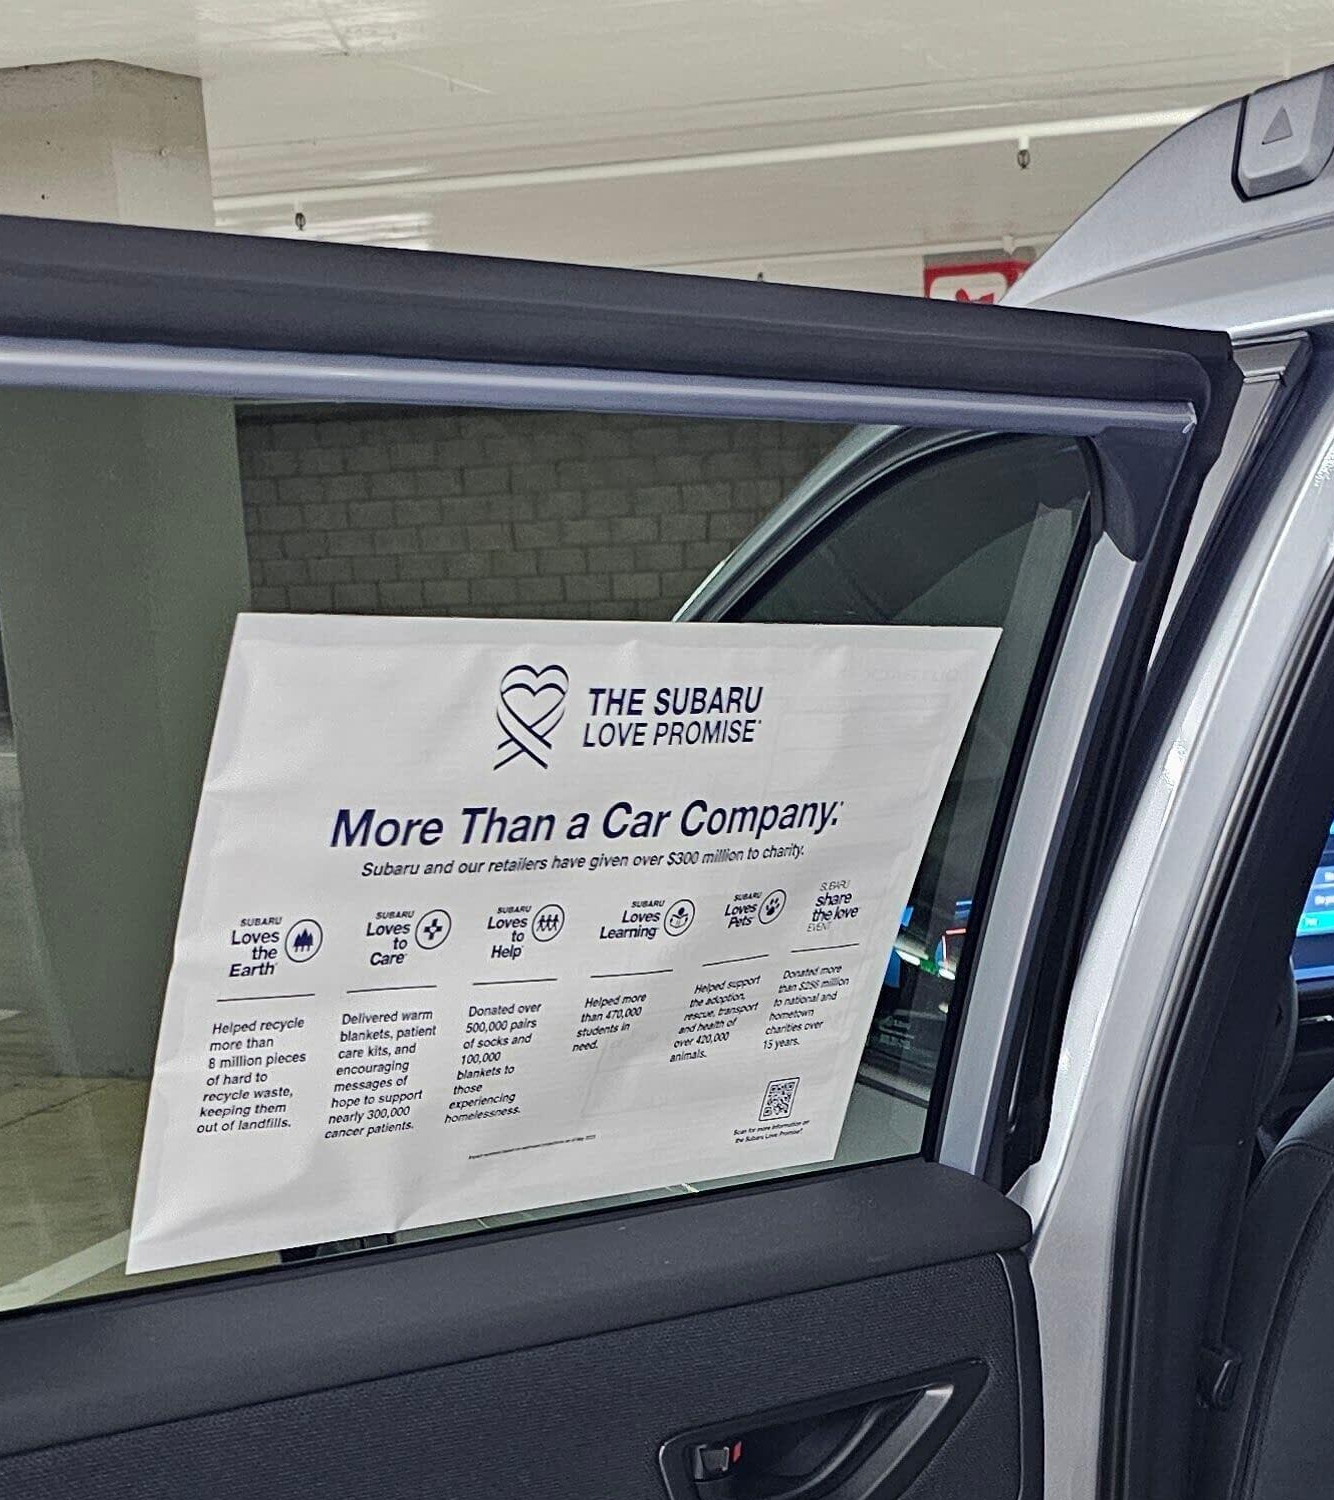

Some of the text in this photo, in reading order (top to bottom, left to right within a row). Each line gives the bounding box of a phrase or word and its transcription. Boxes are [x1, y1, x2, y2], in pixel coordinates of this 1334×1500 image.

[588, 686, 763, 716] THE SUBARU
[582, 722, 648, 748] LOVE
[330, 808, 444, 848] More
[461, 806, 556, 845] Than
[565, 812, 591, 841] a
[602, 801, 671, 839] Car
[361, 843, 805, 877] Subaru and our retailers have given over $300 million to charity.
[733, 892, 762, 901] SUBARU
[816, 892, 852, 907] share
[497, 906, 531, 914] SUBARU
[631, 900, 665, 908] SUBARU
[725, 903, 758, 916] Loves
[376, 910, 415, 920] SUBARU
[622, 910, 660, 923] Loves
[812, 906, 859, 922] the love
[240, 917, 282, 926] SUBARU
[487, 917, 528, 930] Loves
[728, 916, 753, 928] Pets
[807, 922, 832, 932] EVENT
[366, 922, 410, 937] Loves
[511, 930, 525, 943] to
[599, 925, 657, 940] Learning
[231, 930, 279, 945] Loves
[393, 937, 408, 950] to
[252, 947, 277, 960] the
[370, 952, 405, 966] Care
[491, 945, 522, 960] Help
[228, 962, 275, 977] Earth
[694, 975, 761, 994] Helped support
[585, 994, 646, 1008] Helped more
[773, 999, 782, 1007] to
[469, 1003, 542, 1017] Donated over
[342, 1011, 433, 1025] Delivered warm
[581, 1013, 603, 1022] than
[212, 1017, 304, 1035] Helped recycle
[466, 1018, 537, 1034] 500,000 pairs
[576, 1022, 630, 1037] students in
[340, 1025, 436, 1042] blankets, patient
[210, 1037, 274, 1051] more than
[463, 1033, 532, 1049] of socks and
[572, 1040, 598, 1052] need.
[674, 1039, 694, 1048] over
[338, 1043, 417, 1059] care kits, and
[208, 1053, 306, 1069] 8 million pieces
[461, 1052, 501, 1065] 100,000
[336, 1061, 410, 1075] encouraging
[457, 1066, 515, 1080] blankets to
[207, 1072, 268, 1086] of hard to
[334, 1075, 408, 1092] messages of
[203, 1087, 293, 1103] recycle waste,
[453, 1084, 483, 1095] those
[331, 1090, 423, 1109] hope to support
[449, 1093, 516, 1110] experiencing
[200, 1104, 286, 1118] keeping them
[328, 1106, 411, 1124] nearly 300,000
[444, 1106, 521, 1124] homelessness.
[197, 1118, 291, 1133] out of landfills.
[325, 1121, 414, 1139] cancer patients.
